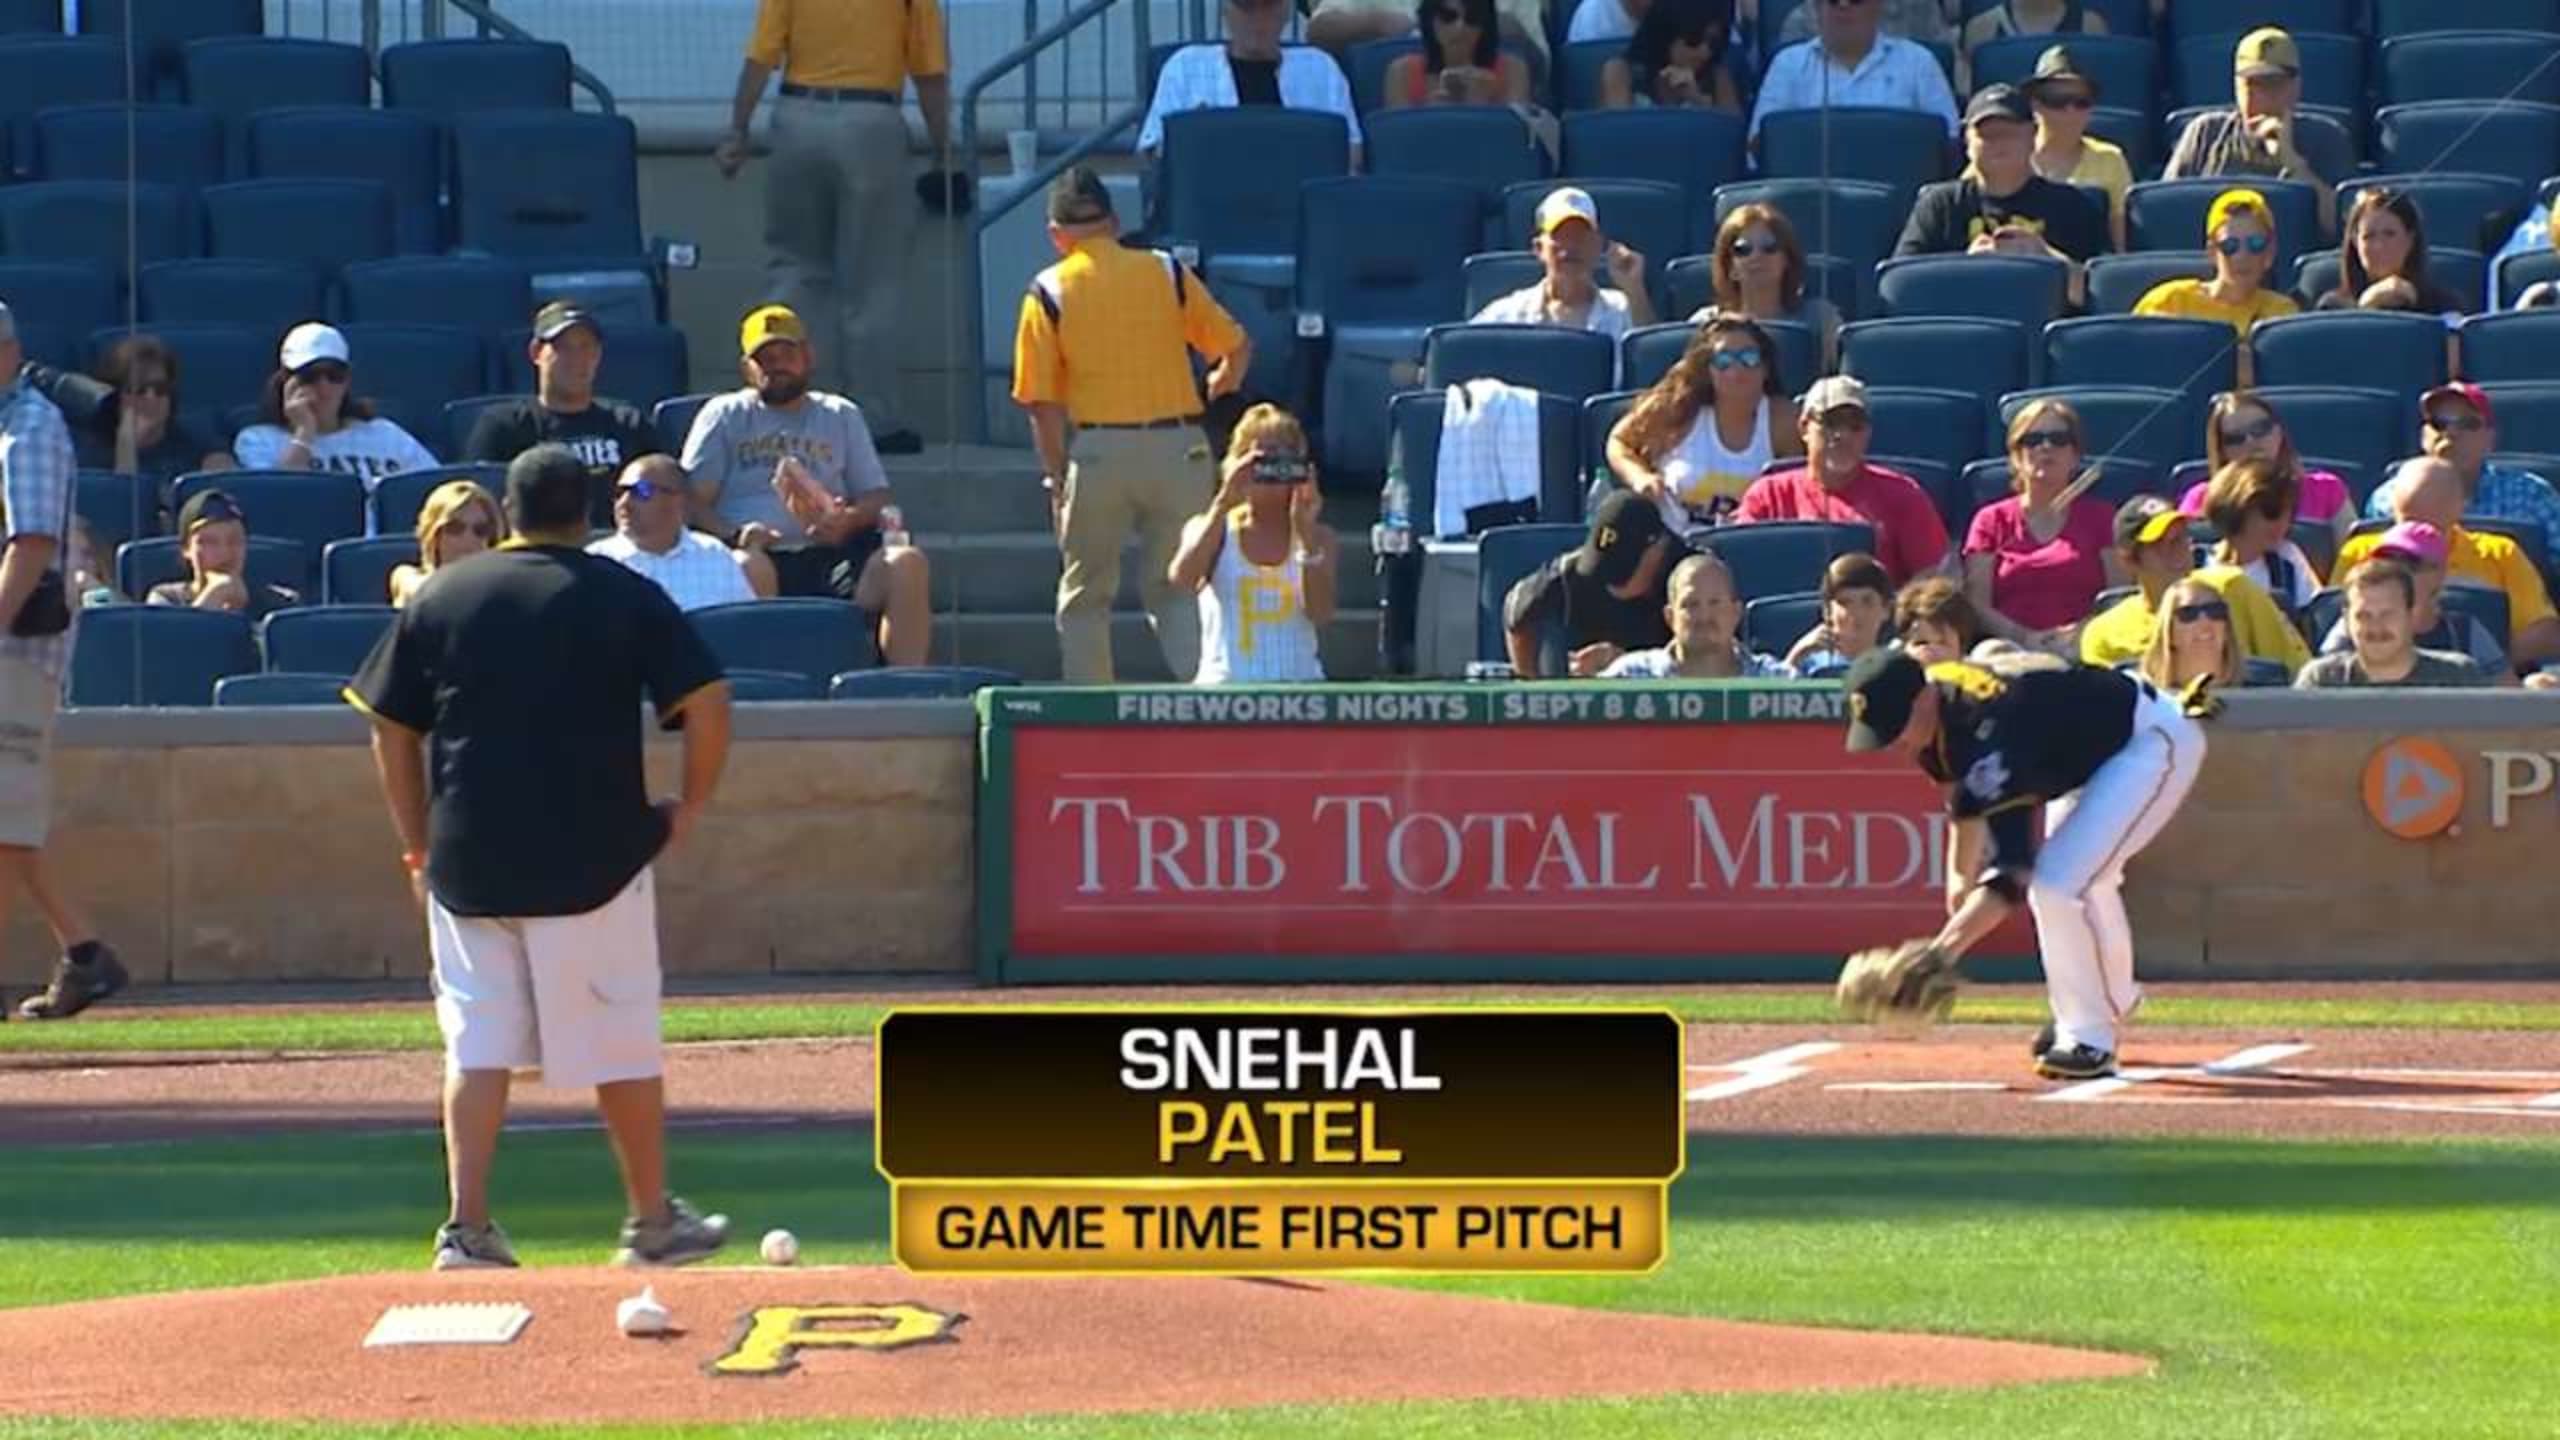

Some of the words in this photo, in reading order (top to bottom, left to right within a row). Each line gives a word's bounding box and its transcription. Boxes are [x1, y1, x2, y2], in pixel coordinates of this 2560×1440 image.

[1600, 526, 1617, 549] P
[1238, 575, 1297, 657] P
[1118, 695, 1327, 721] FIREWORKS
[1337, 694, 1468, 721] NIGHTS
[1504, 693, 1594, 720] SEPT
[1604, 693, 1625, 720] 8
[1634, 693, 1656, 719] &
[1666, 693, 1703, 719] 10
[1749, 692, 1846, 718] PIRAT
[2480, 750, 2560, 828] P
[1049, 795, 1287, 892] TRIB
[1312, 795, 1661, 894] TOTAL
[1687, 793, 1948, 891] MEDI
[707, 1301, 971, 1376] P
